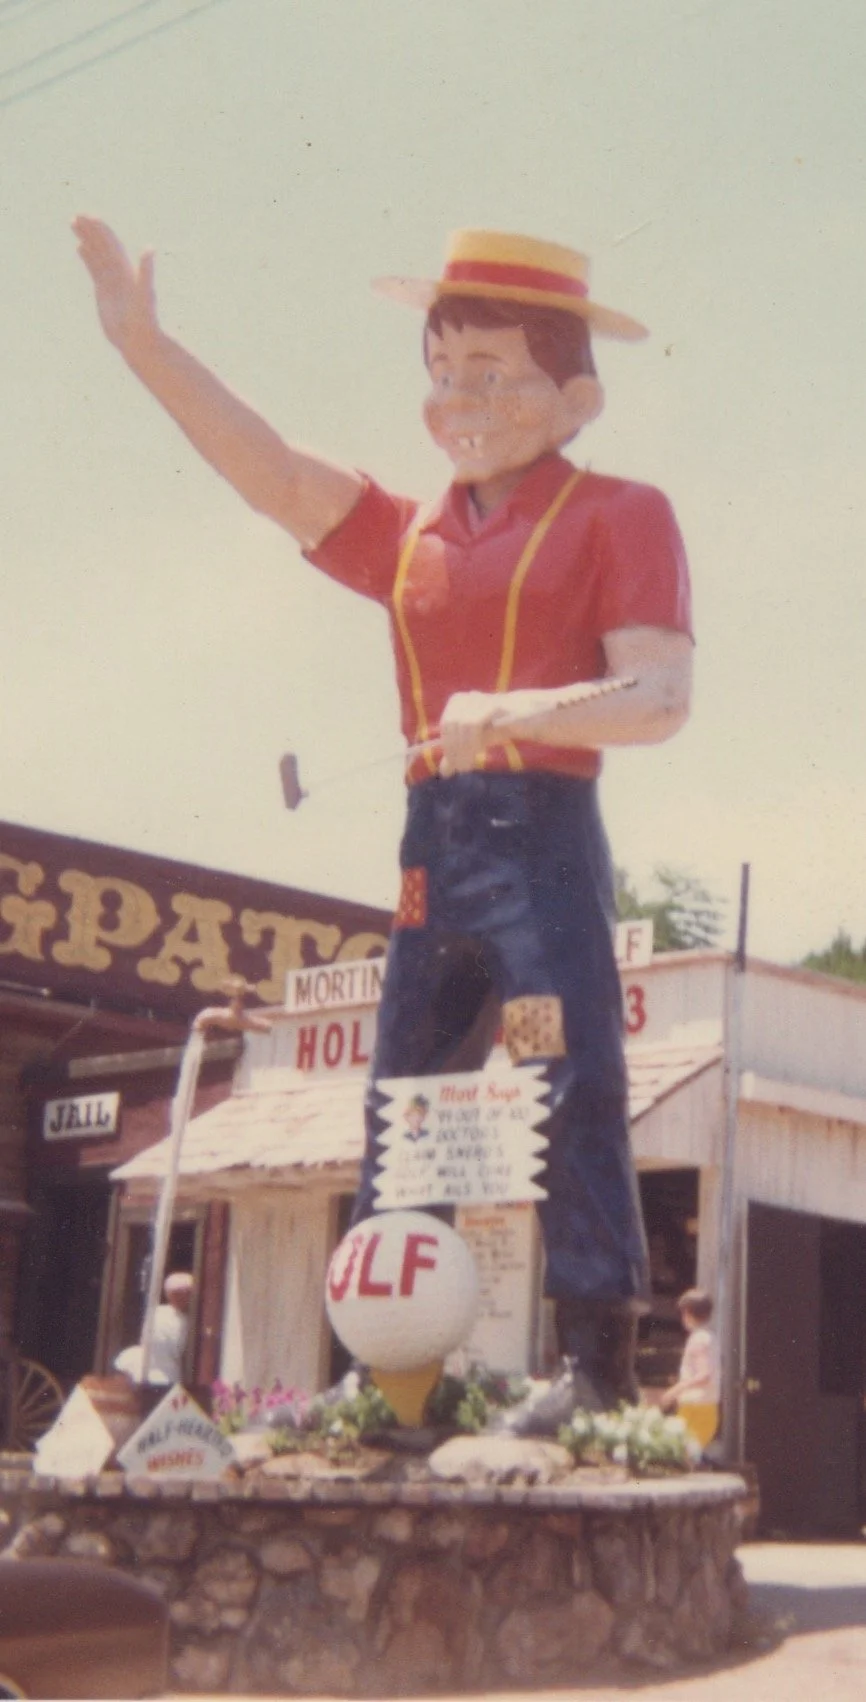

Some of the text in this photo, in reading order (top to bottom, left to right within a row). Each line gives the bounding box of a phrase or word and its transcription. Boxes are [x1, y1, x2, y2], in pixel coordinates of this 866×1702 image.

[626, 984, 647, 1034] 3
[49, 1099, 112, 1134] JAIL
[455, 1106, 481, 1122] OUT
[146, 1449, 206, 1473] WISHES
